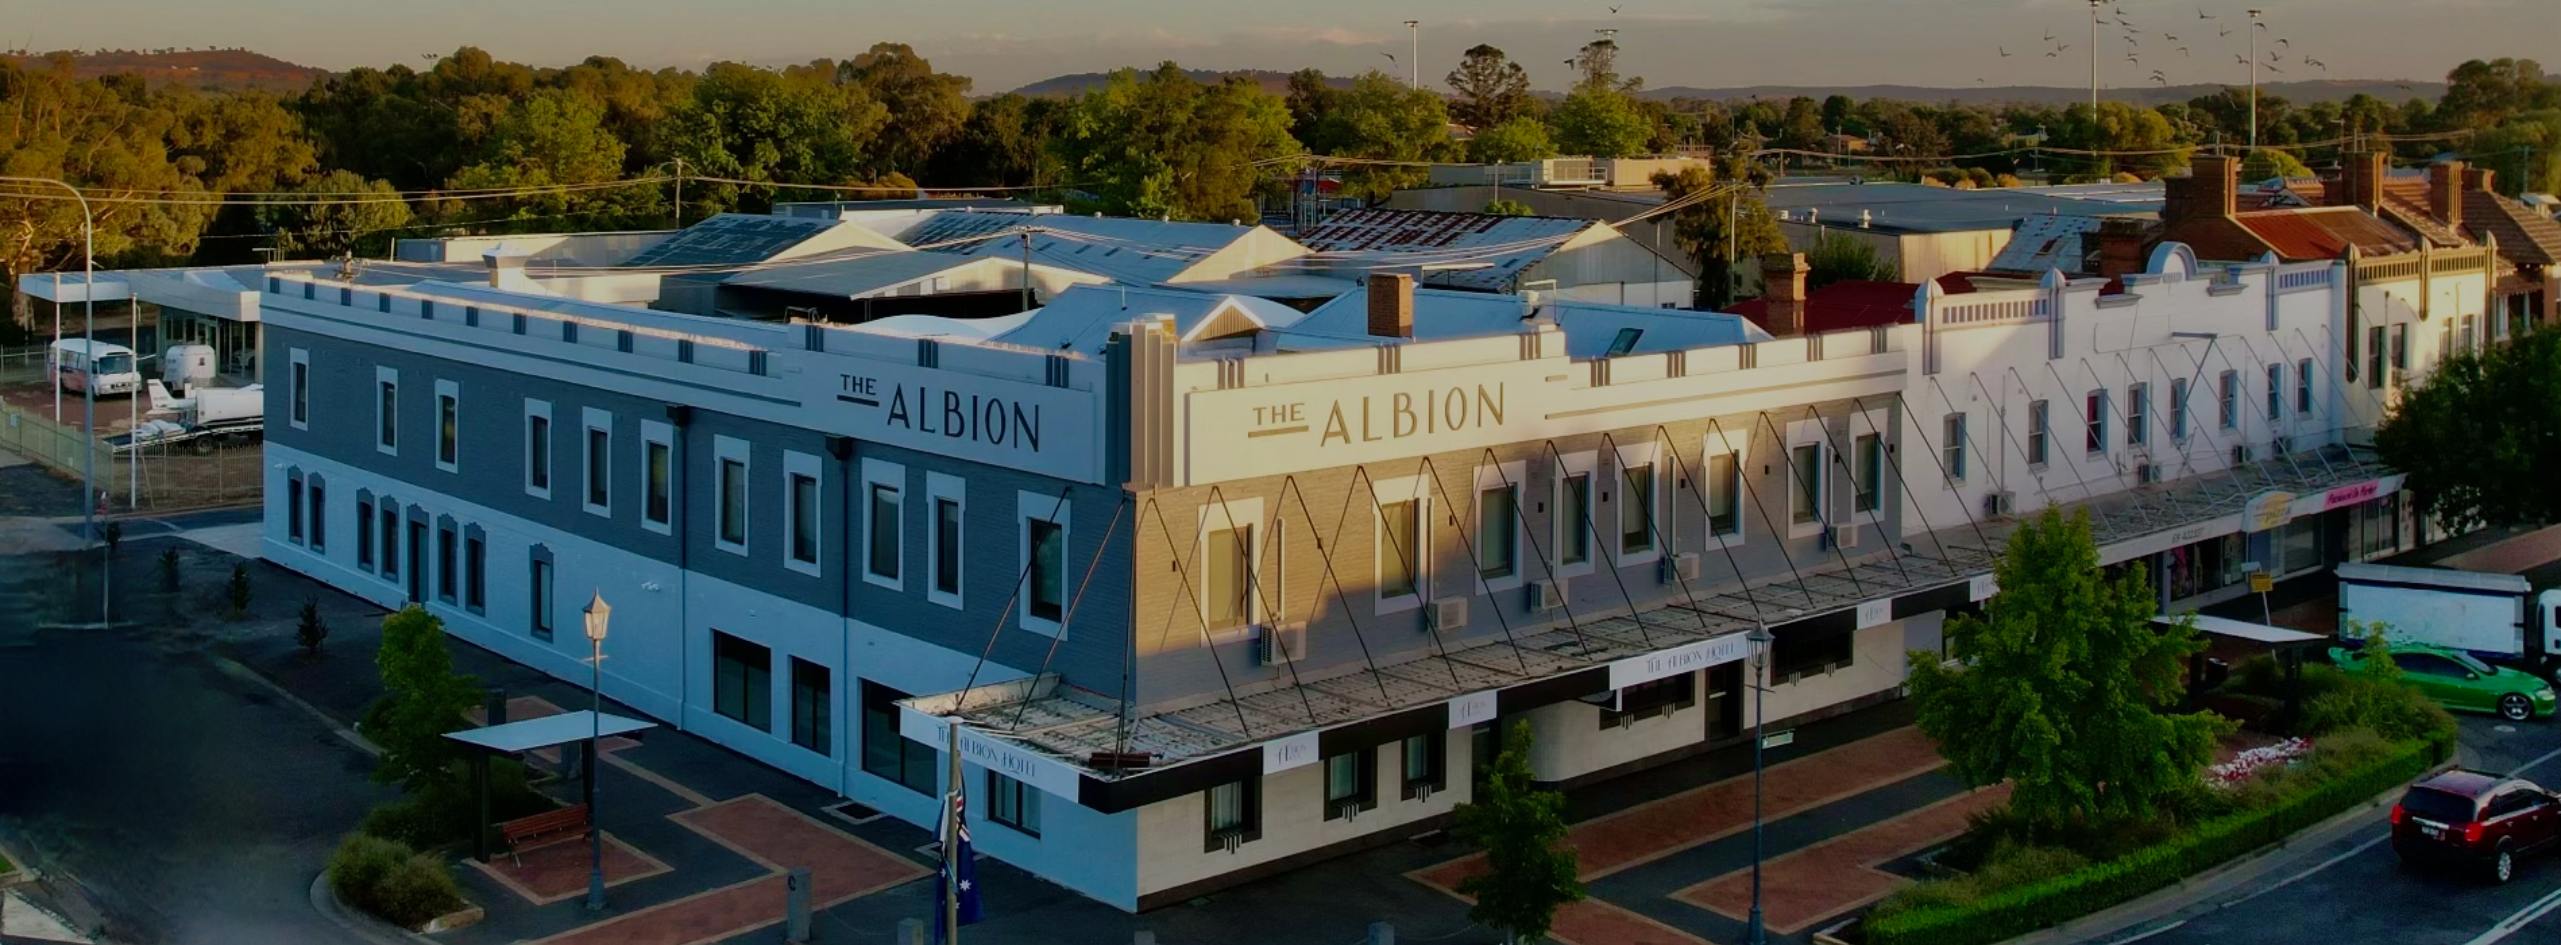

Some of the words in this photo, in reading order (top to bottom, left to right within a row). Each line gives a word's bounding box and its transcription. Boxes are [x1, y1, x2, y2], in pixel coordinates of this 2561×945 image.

[840, 373, 877, 396] THE
[887, 383, 1040, 452] ALBION
[1252, 403, 1306, 426] THE
[1320, 382, 1504, 447] ALBION
[960, 736, 999, 763] ALBION
[1003, 751, 1037, 777] HOTEL
